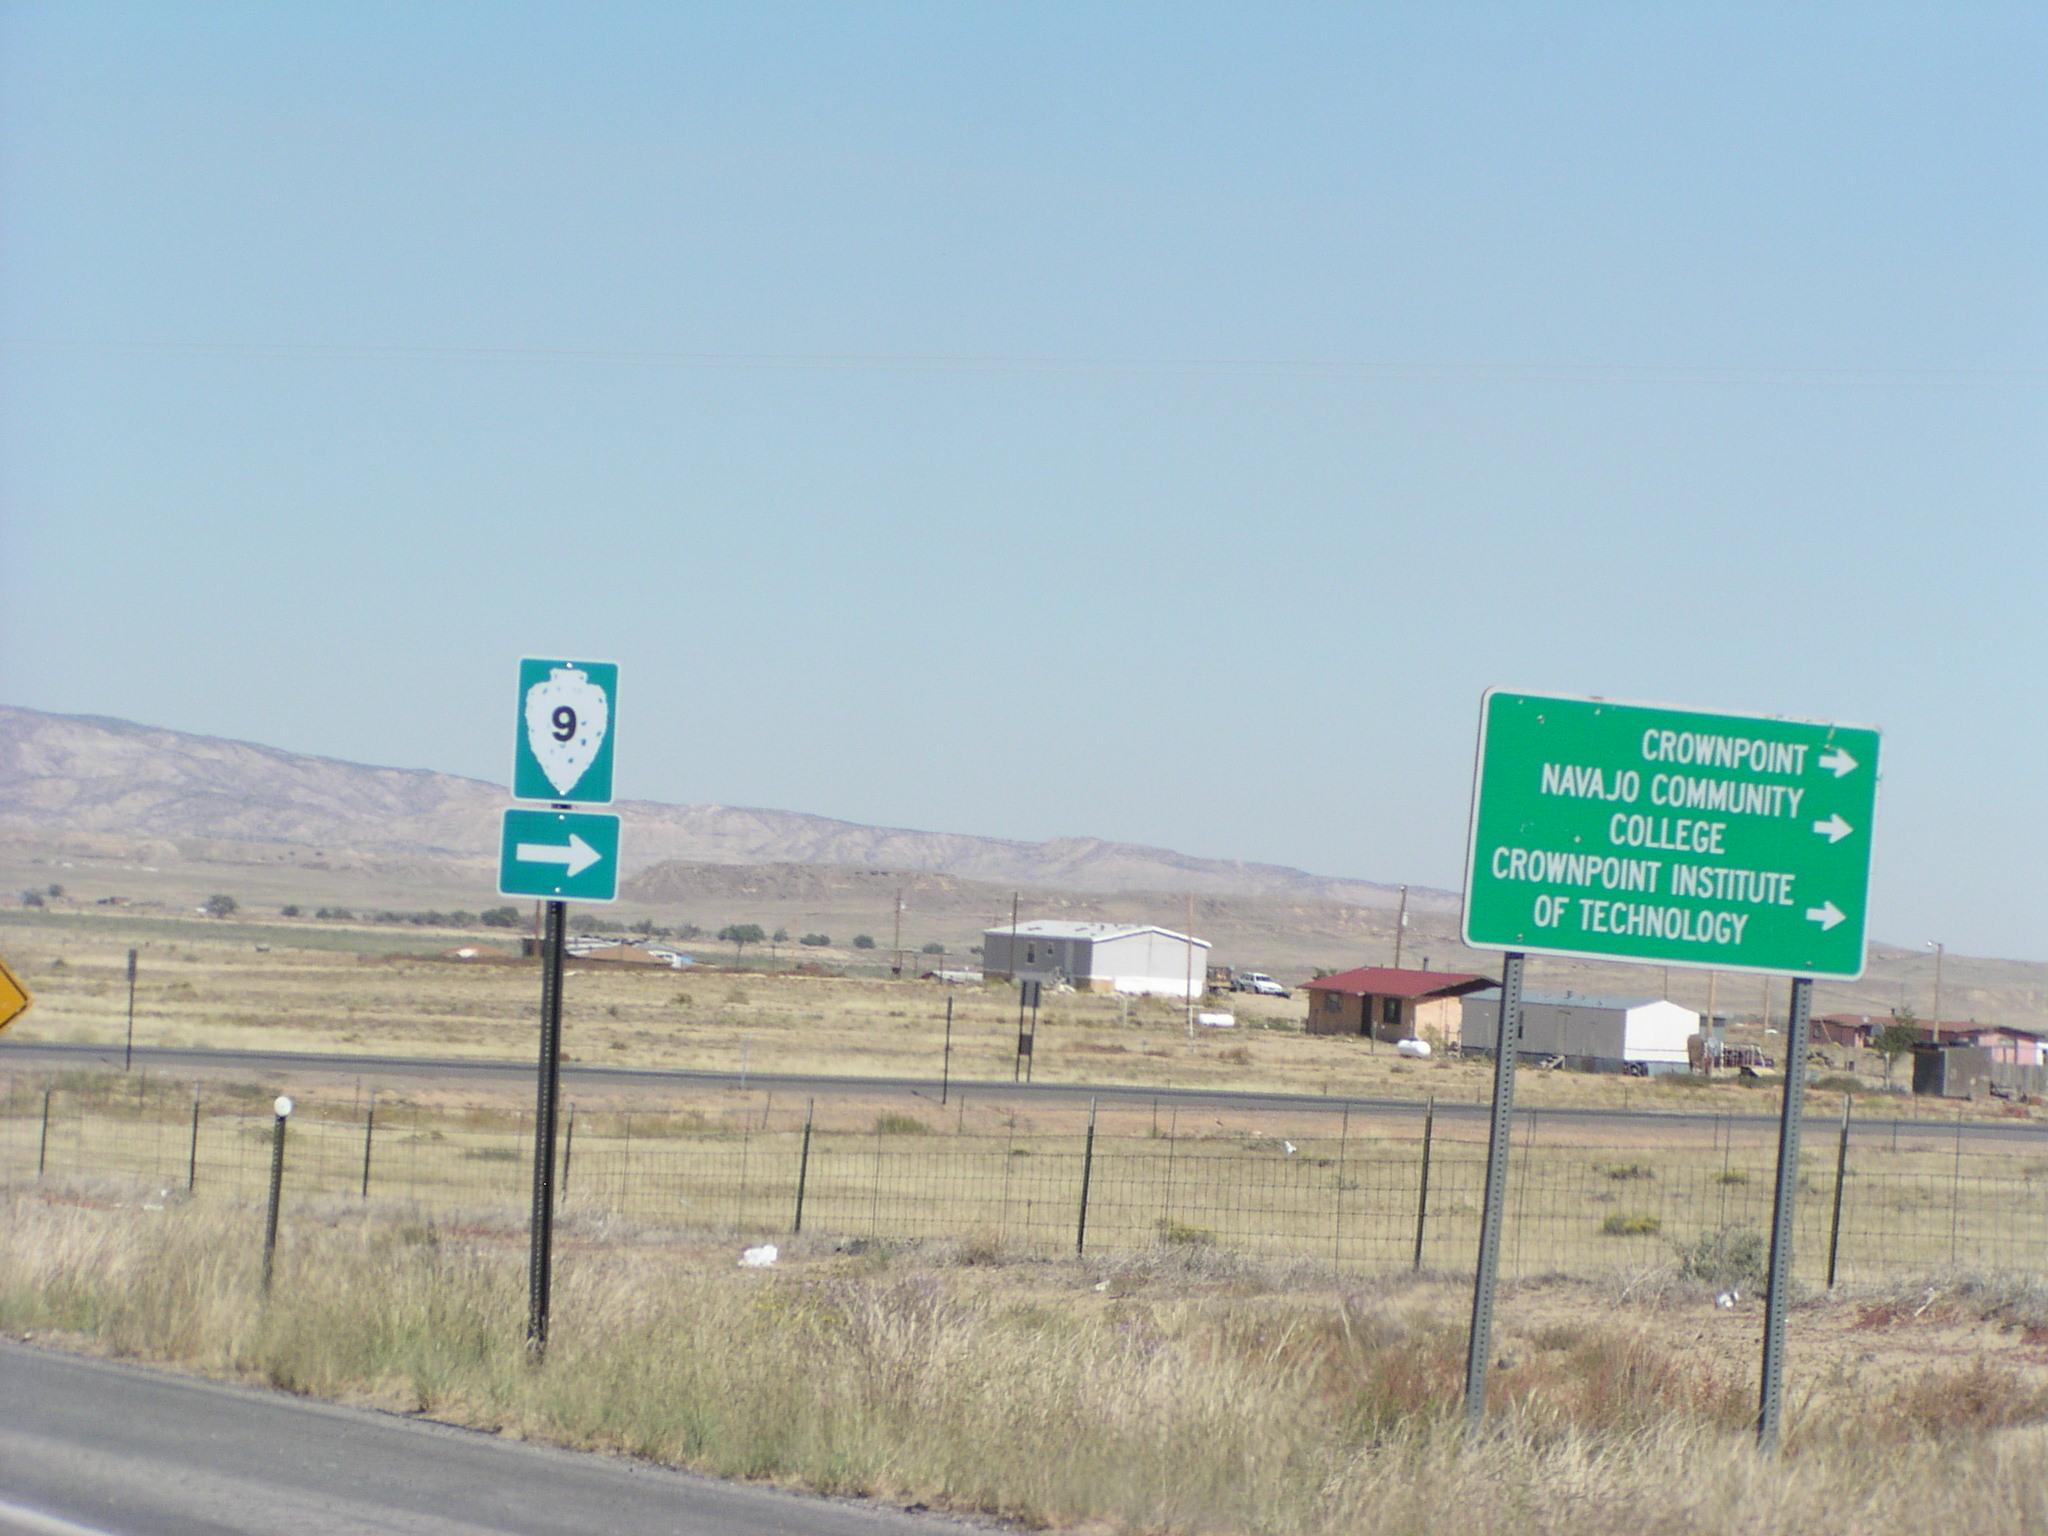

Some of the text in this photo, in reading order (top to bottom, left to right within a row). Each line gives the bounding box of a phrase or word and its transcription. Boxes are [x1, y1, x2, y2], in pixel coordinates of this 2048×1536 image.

[553, 706, 576, 742] 9
[1642, 728, 1808, 775] CROWNPOINT
[1541, 763, 1804, 818] NAVAJO COMMUNITY
[1609, 813, 1727, 855] COLLEGE
[1492, 847, 1796, 905] CROWNPOINT INSTITUTE
[1534, 895, 1749, 945] OF TECHNOLOGY
